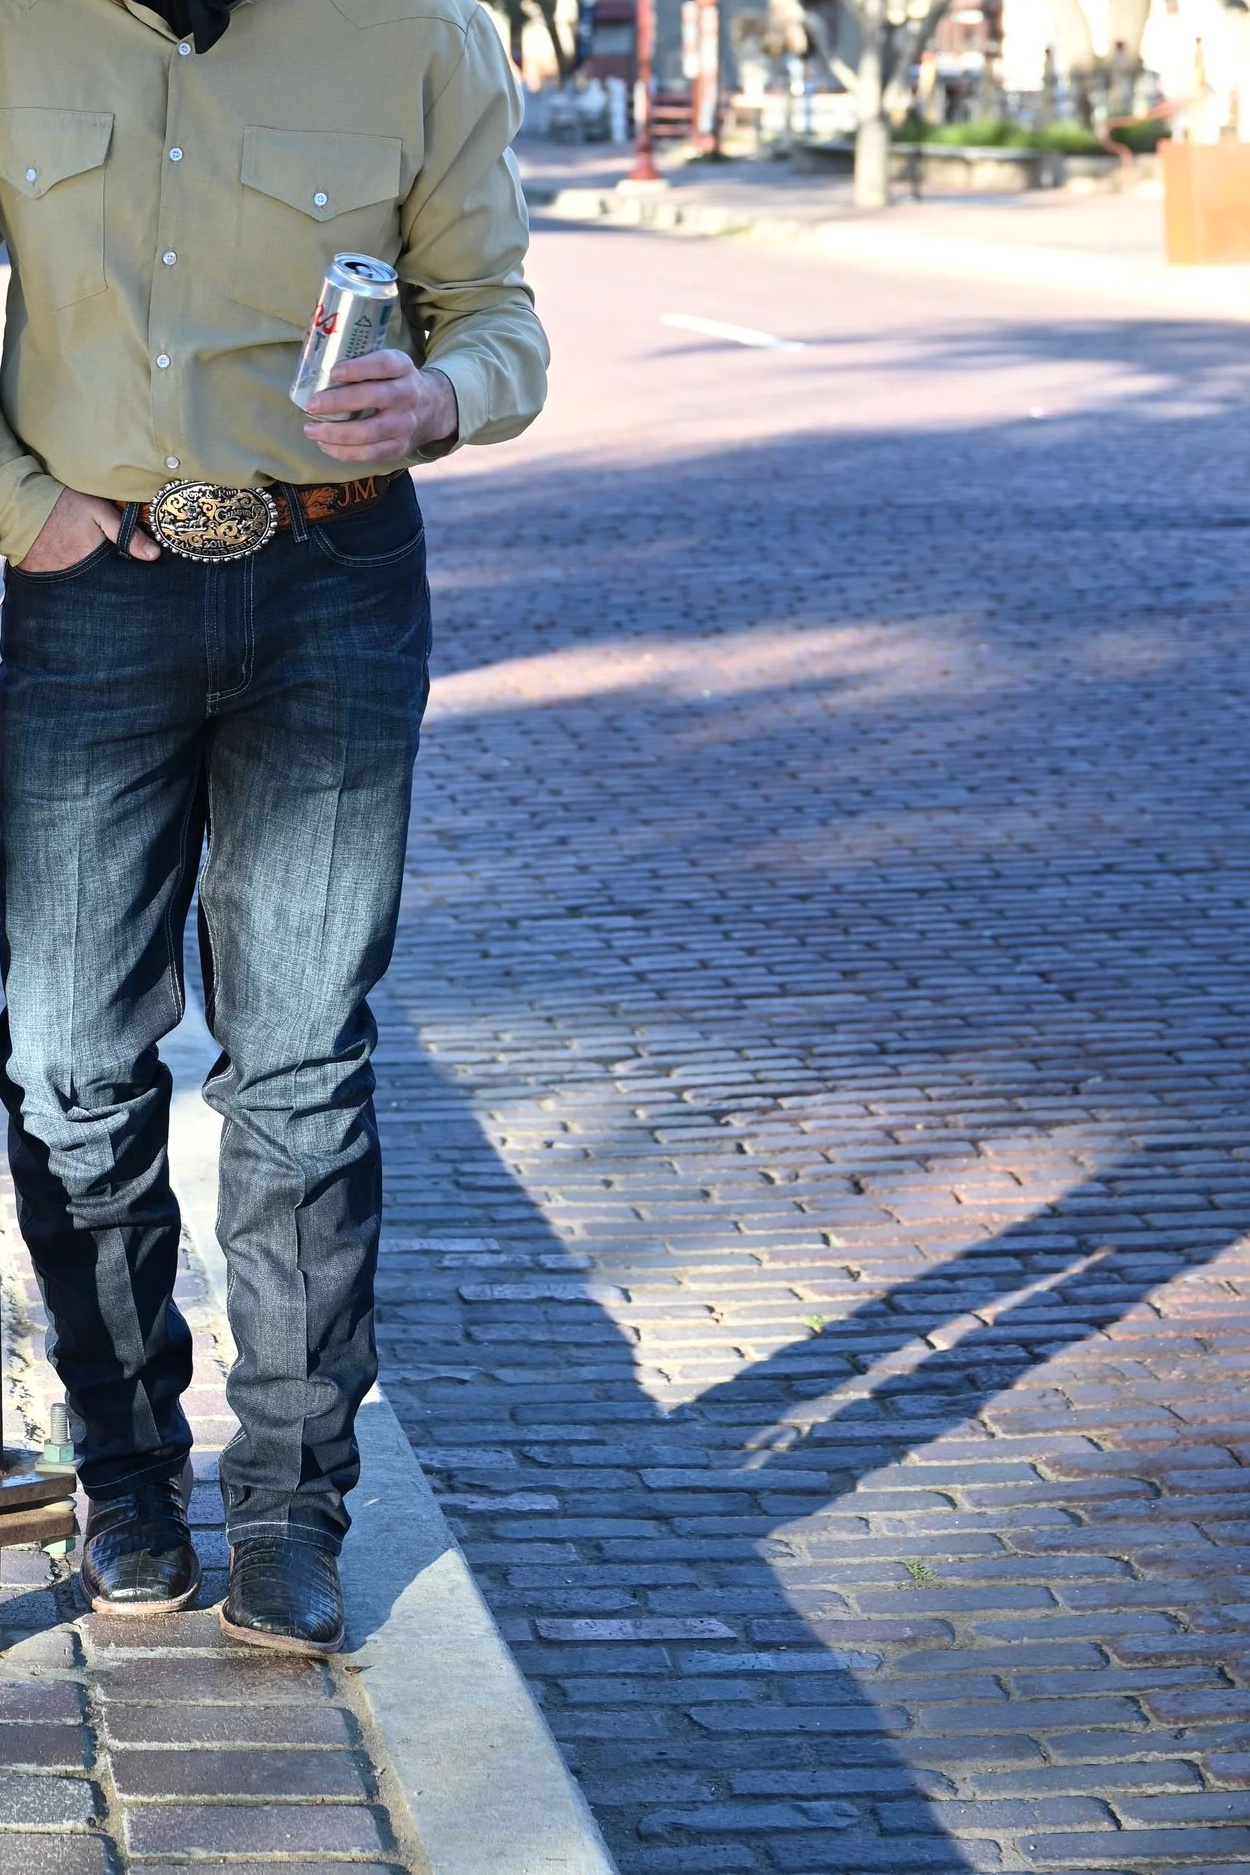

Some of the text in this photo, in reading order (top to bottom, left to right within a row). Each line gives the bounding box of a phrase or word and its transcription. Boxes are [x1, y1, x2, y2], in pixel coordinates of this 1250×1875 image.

[180, 489, 237, 502] Rope & Run
[337, 476, 378, 507] JM
[169, 537, 195, 552] TEAM
[203, 540, 224, 549] 2011
